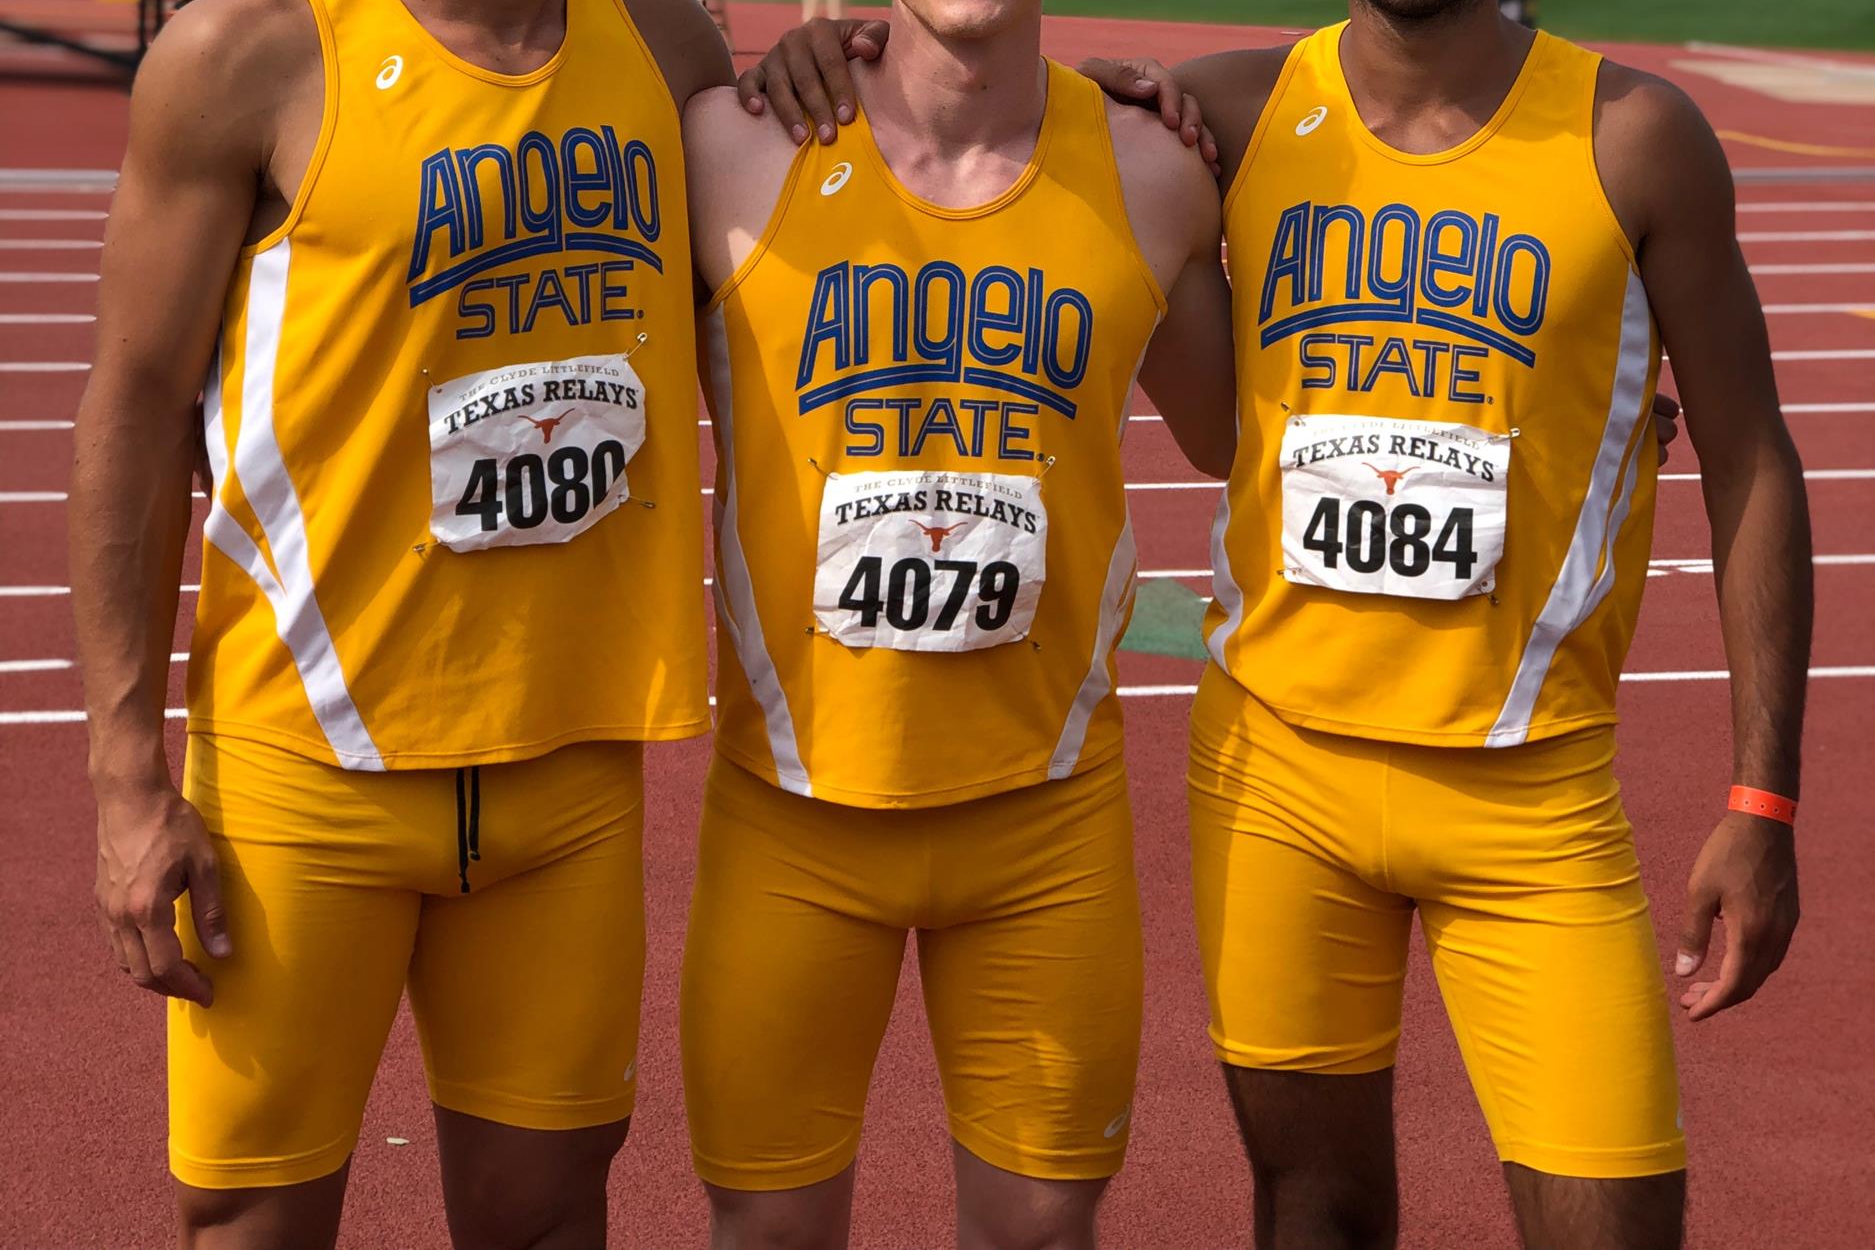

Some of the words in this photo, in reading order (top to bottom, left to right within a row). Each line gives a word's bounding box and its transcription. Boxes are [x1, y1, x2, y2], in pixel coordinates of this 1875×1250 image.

[406, 125, 661, 286] Angelo
[1257, 200, 1550, 336] Angelo
[795, 260, 1093, 390] Angelo
[443, 384, 535, 436] TEXAS
[543, 379, 638, 409] RELAYS
[489, 367, 537, 385] CLYDE
[542, 364, 620, 377] LITTLEFIELD
[455, 440, 626, 531] 4080
[887, 475, 932, 487] CLYDE
[936, 475, 1023, 500] LITTLEFIELD
[1293, 434, 1380, 468] TEXAS
[1388, 434, 1495, 482] RELAYS
[835, 490, 928, 526] TEXAS
[934, 489, 1037, 535] RELAYS
[1303, 496, 1478, 580] 4084
[838, 556, 1021, 632] 4079
